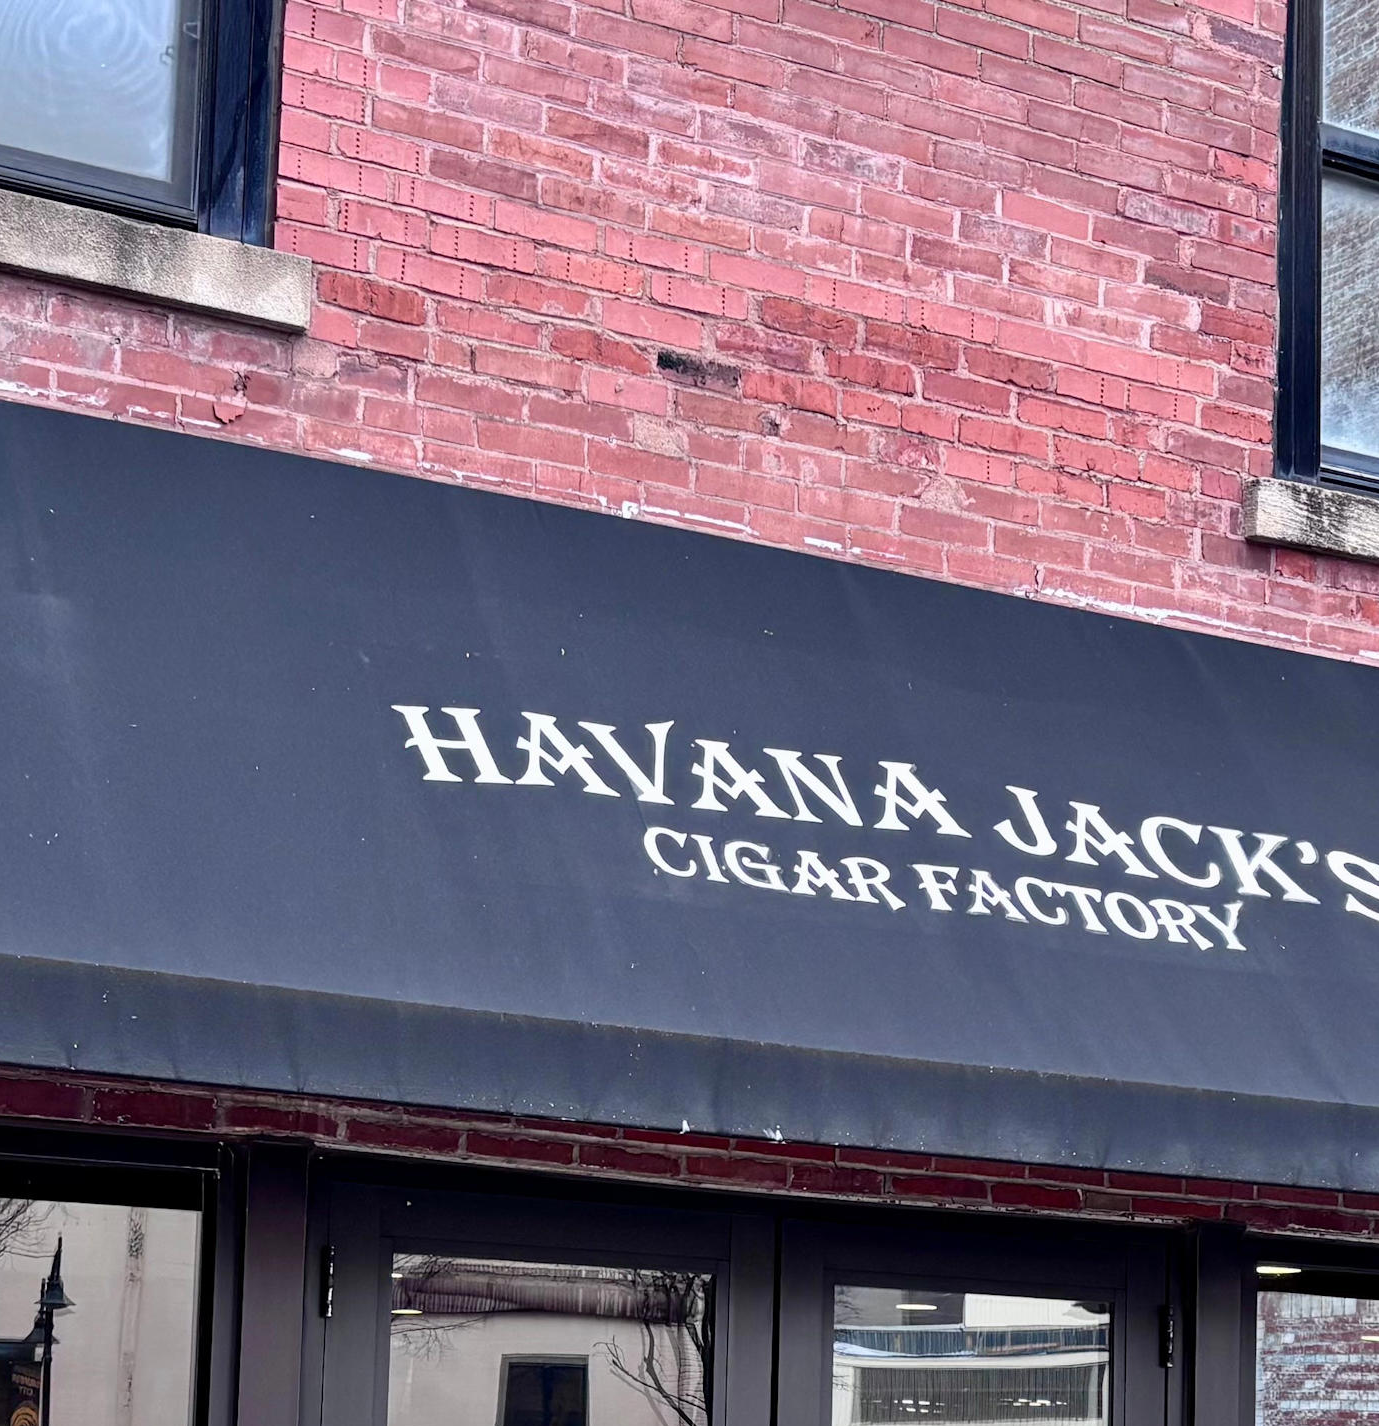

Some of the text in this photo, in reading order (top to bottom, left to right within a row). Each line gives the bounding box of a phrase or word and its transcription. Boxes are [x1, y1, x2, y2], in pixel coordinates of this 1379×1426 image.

[390, 704, 973, 839] HAVANA
[643, 826, 1247, 951] CIGAR FACTORY
